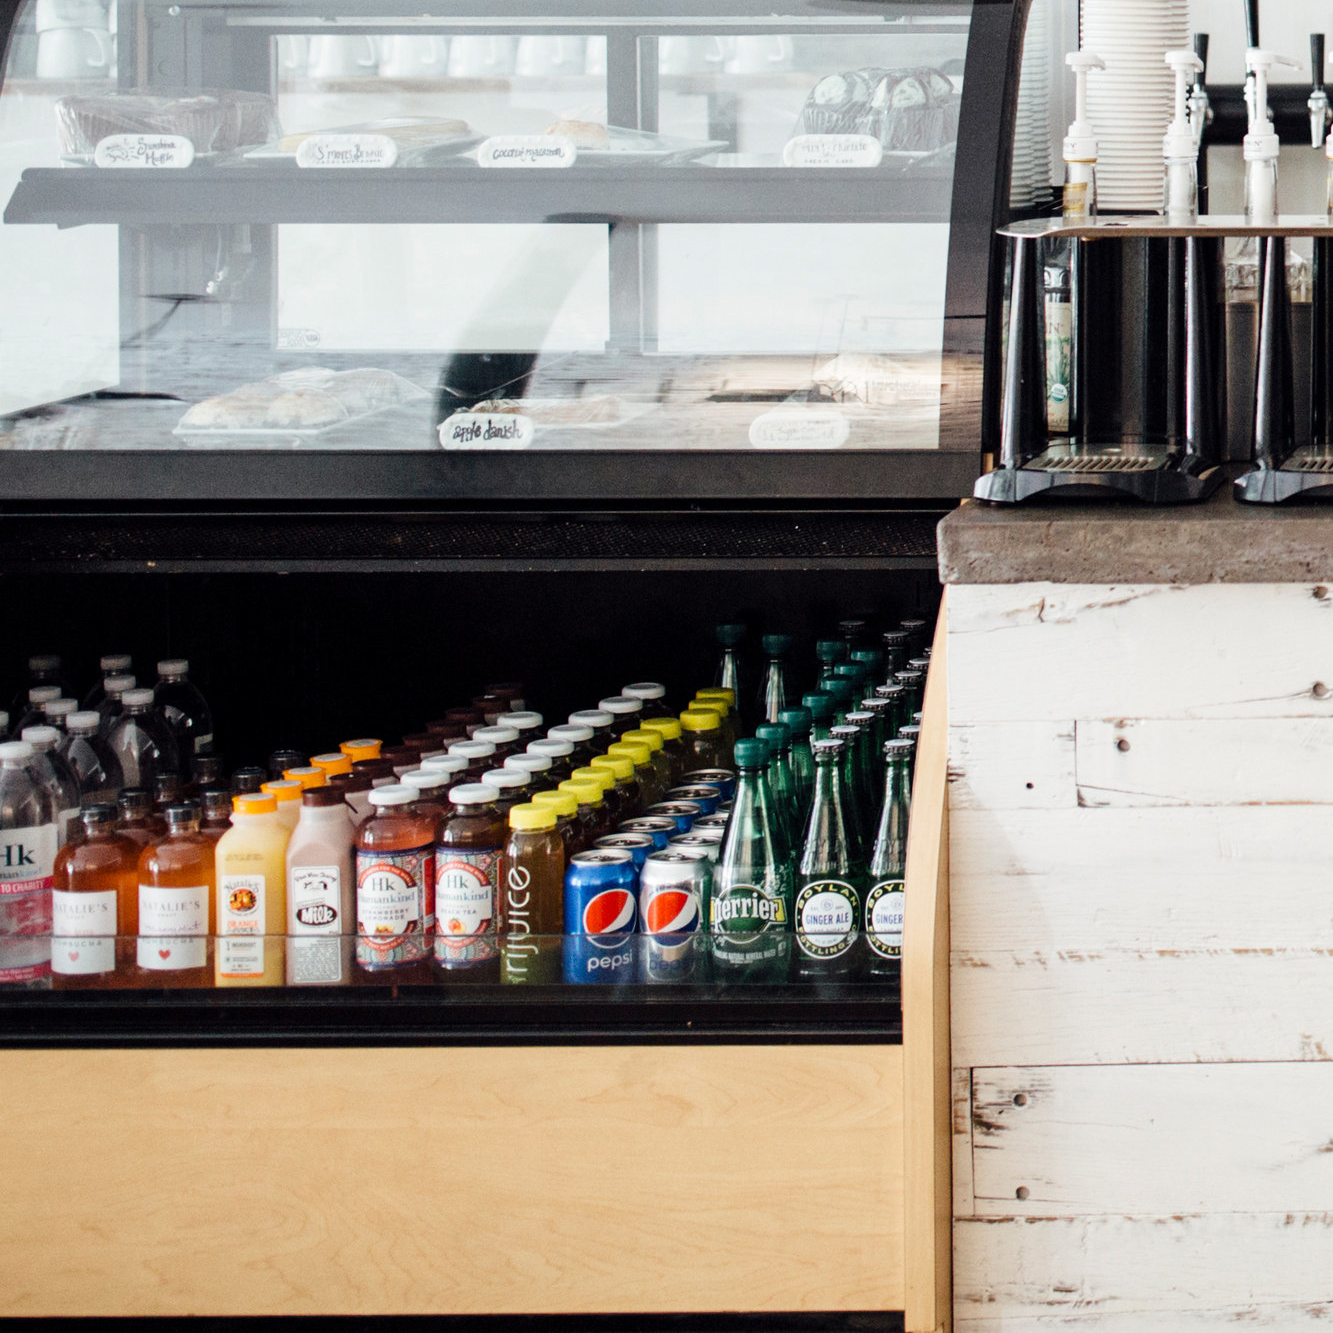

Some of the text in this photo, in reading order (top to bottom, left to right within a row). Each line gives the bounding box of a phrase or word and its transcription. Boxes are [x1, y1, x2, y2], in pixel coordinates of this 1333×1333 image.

[453, 419, 524, 442] apple danish
[12, 880, 44, 893] CHARITY
[372, 877, 394, 890] Hk
[447, 875, 468, 888] Hk
[798, 884, 857, 909] BOYLAN
[302, 905, 334, 923] Milk
[806, 913, 849, 925] GINGER ALE
[876, 915, 903, 925] GINGER
[587, 949, 633, 972] pepsi
